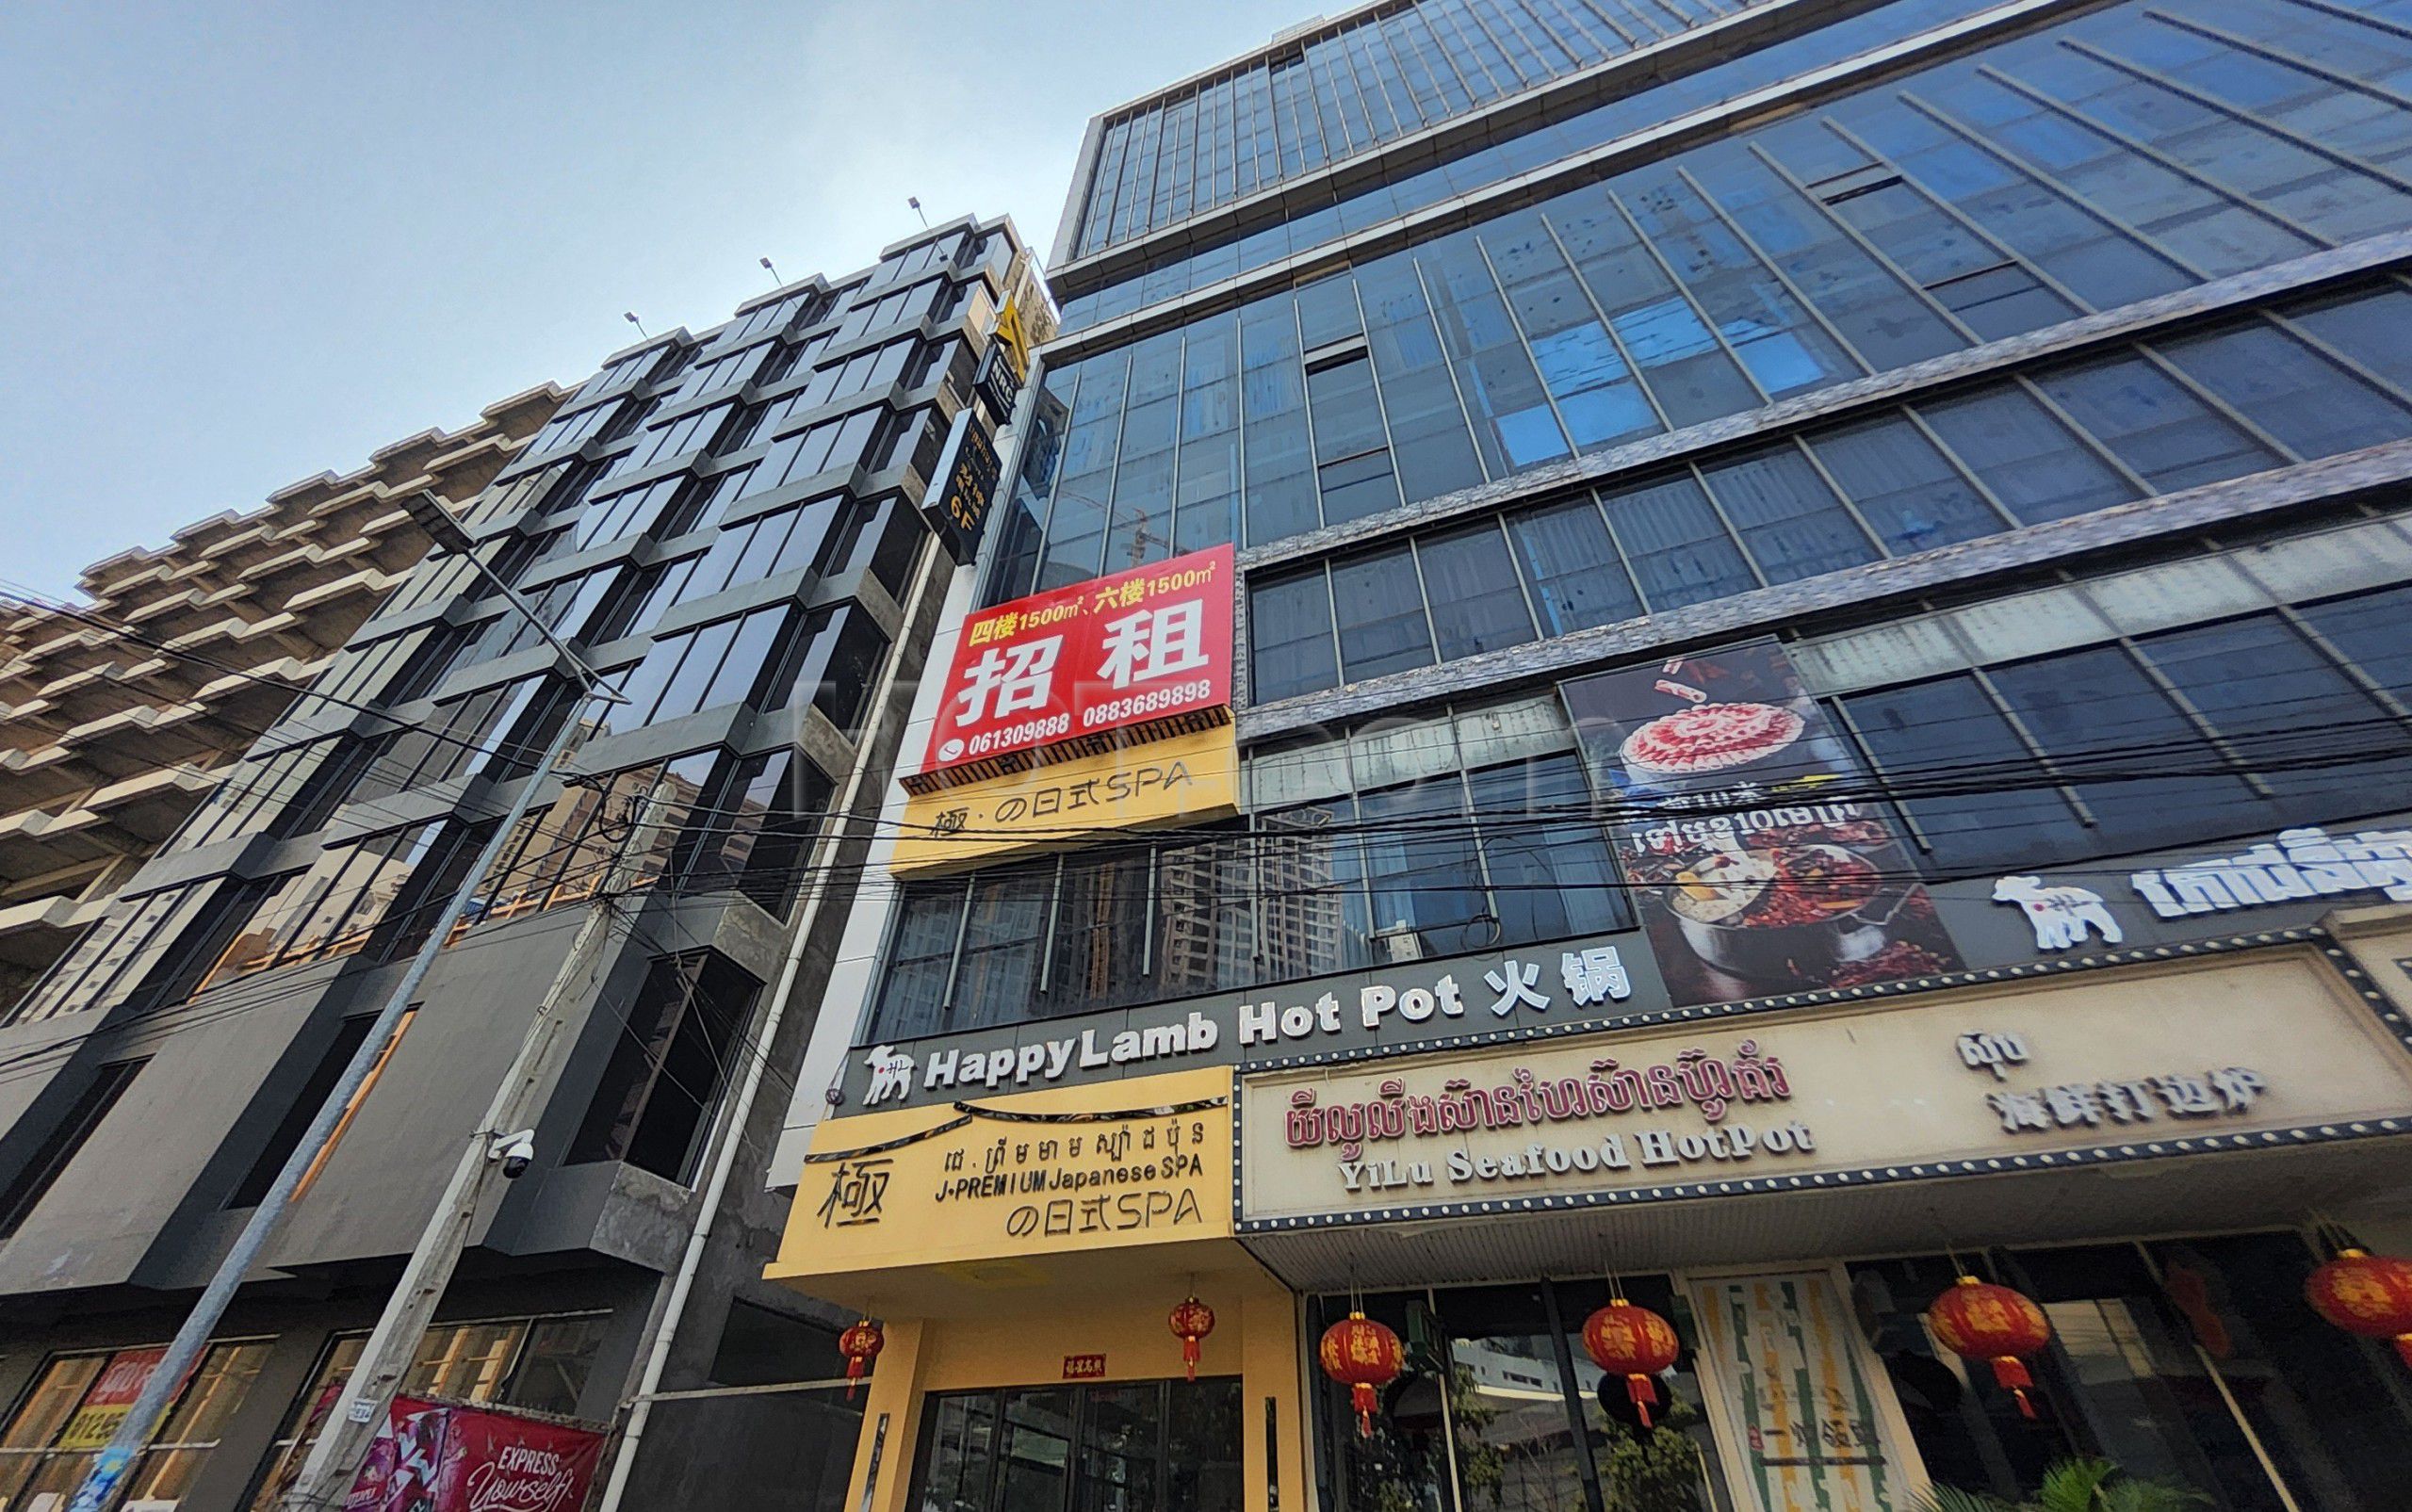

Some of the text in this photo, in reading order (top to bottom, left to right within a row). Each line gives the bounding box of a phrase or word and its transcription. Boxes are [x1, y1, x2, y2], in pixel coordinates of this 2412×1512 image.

[969, 679, 1212, 756] 061309888 0883689898
[1238, 991, 1341, 1048] Hot
[1361, 974, 1466, 1029] Pot
[1483, 945, 1633, 1017] 火锅
[1049, 1164, 1157, 1192] Japanese
[1160, 1153, 1204, 1179] SPA
[1338, 1120, 1817, 1192] YiLu Seafood HotPot
[497, 1444, 561, 1476] EXPRESS
